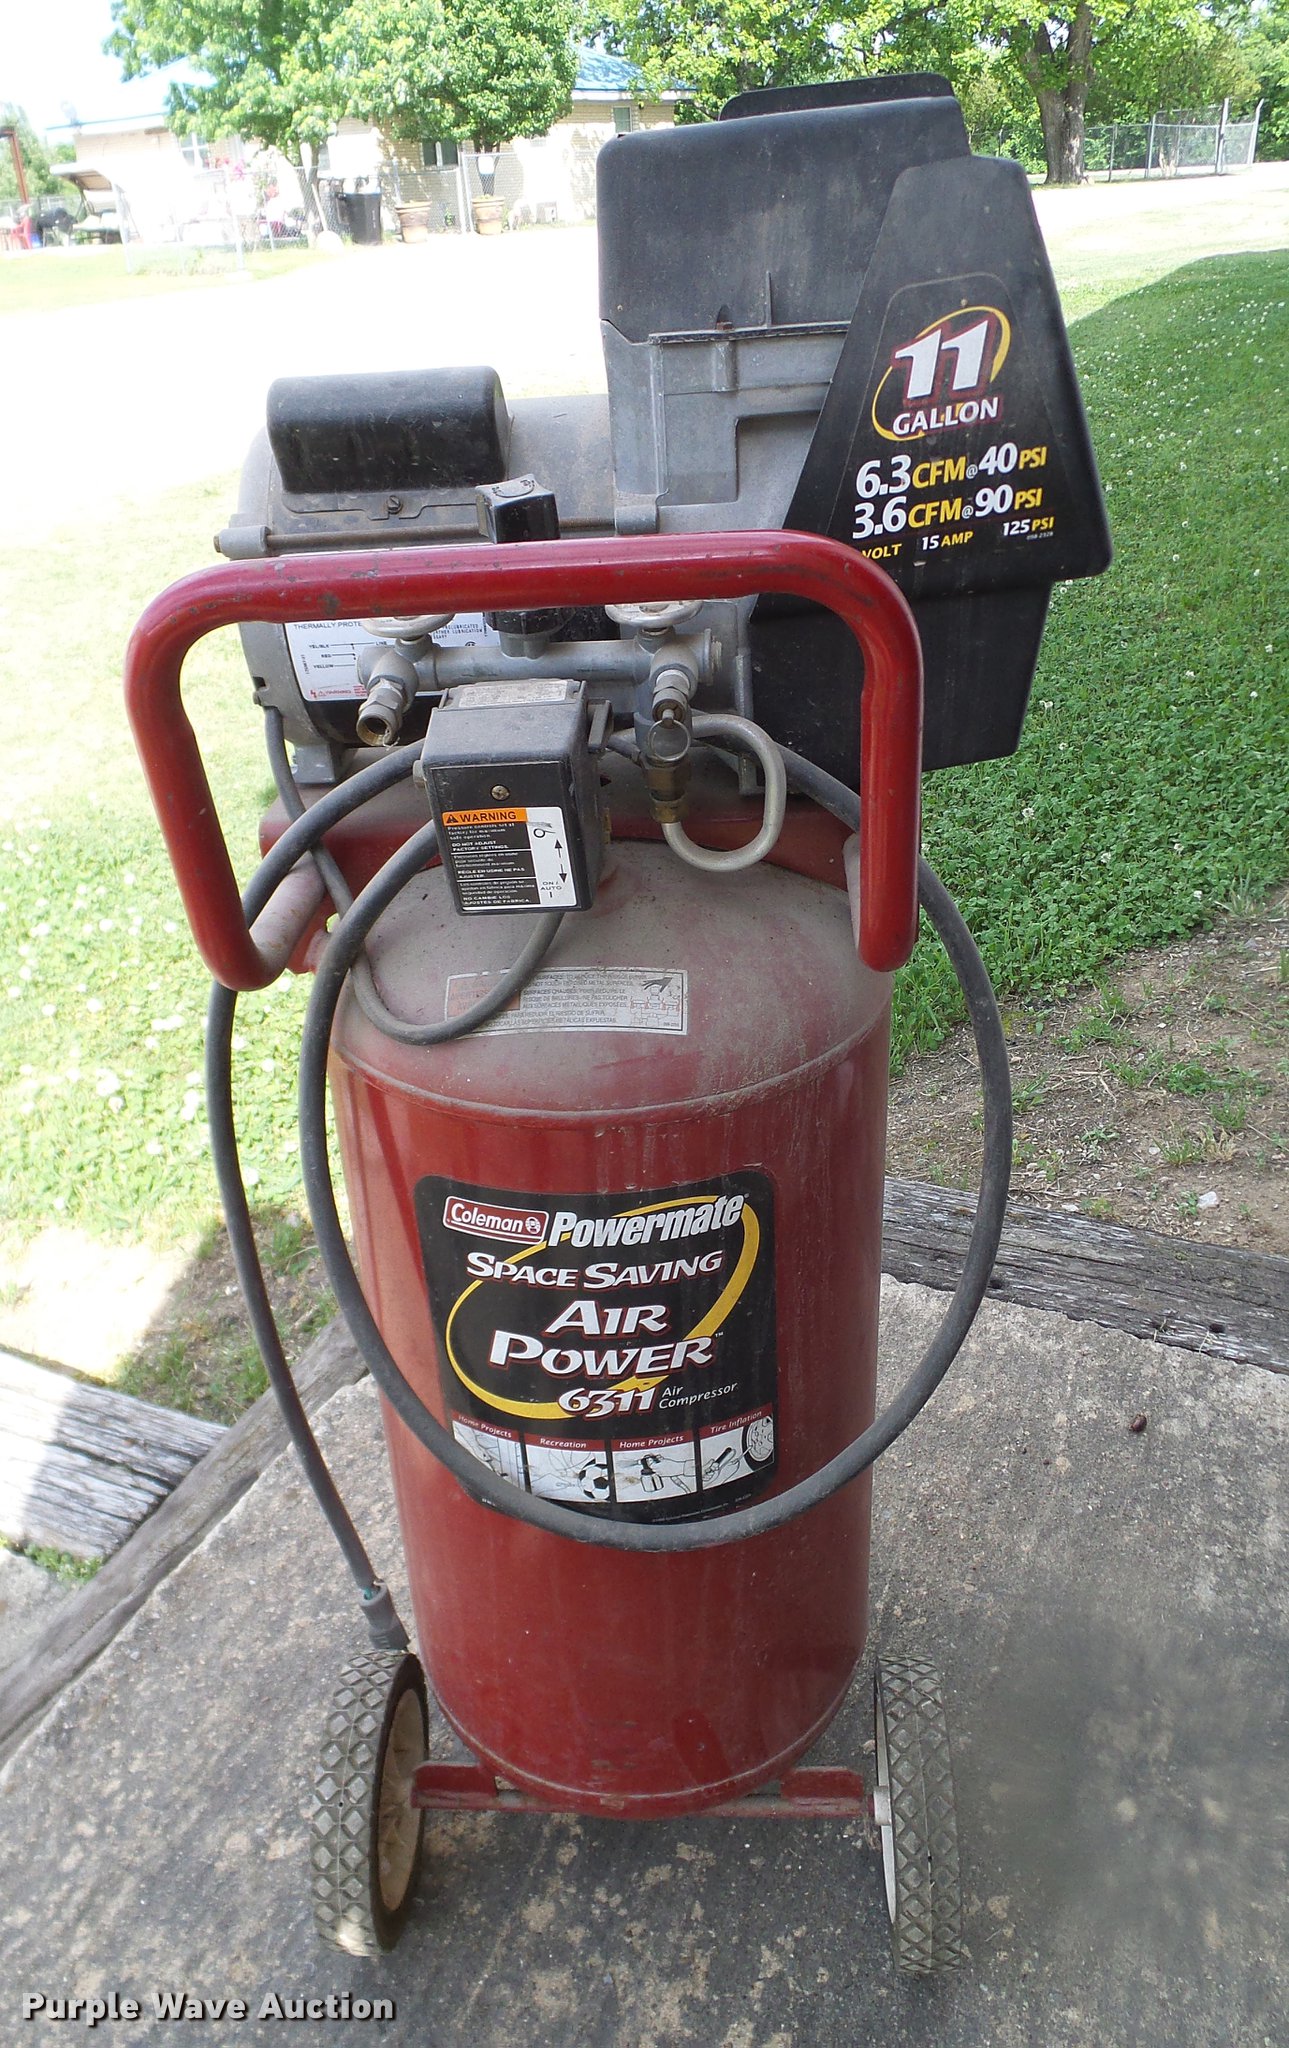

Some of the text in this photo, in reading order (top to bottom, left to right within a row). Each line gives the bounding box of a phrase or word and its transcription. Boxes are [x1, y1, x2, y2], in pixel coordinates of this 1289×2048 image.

[894, 319, 988, 399] 11
[892, 397, 998, 436] GALLON
[1018, 446, 1047, 470] PSI
[1014, 488, 1043, 511] PSI
[922, 535, 940, 551] 15
[940, 531, 974, 549] AMP
[1002, 518, 1030, 537] 125
[1031, 516, 1055, 532] PSI
[293, 622, 337, 630] THERMALLY
[459, 811, 517, 823] WARNING
[450, 1194, 745, 1249] Coleman Powermate
[466, 1250, 723, 1290] SPACE SAVING
[545, 1300, 668, 1336] AIR
[489, 1330, 713, 1377] POWER
[557, 1387, 653, 1417] 6311
[658, 1382, 738, 1409] Compressor
[661, 1385, 684, 1398] Air
[458, 1414, 513, 1439] Home Projects
[710, 1409, 762, 1434] Tire Inflation
[539, 1437, 587, 1450] Recreation
[619, 1434, 684, 1449] Home Projects
